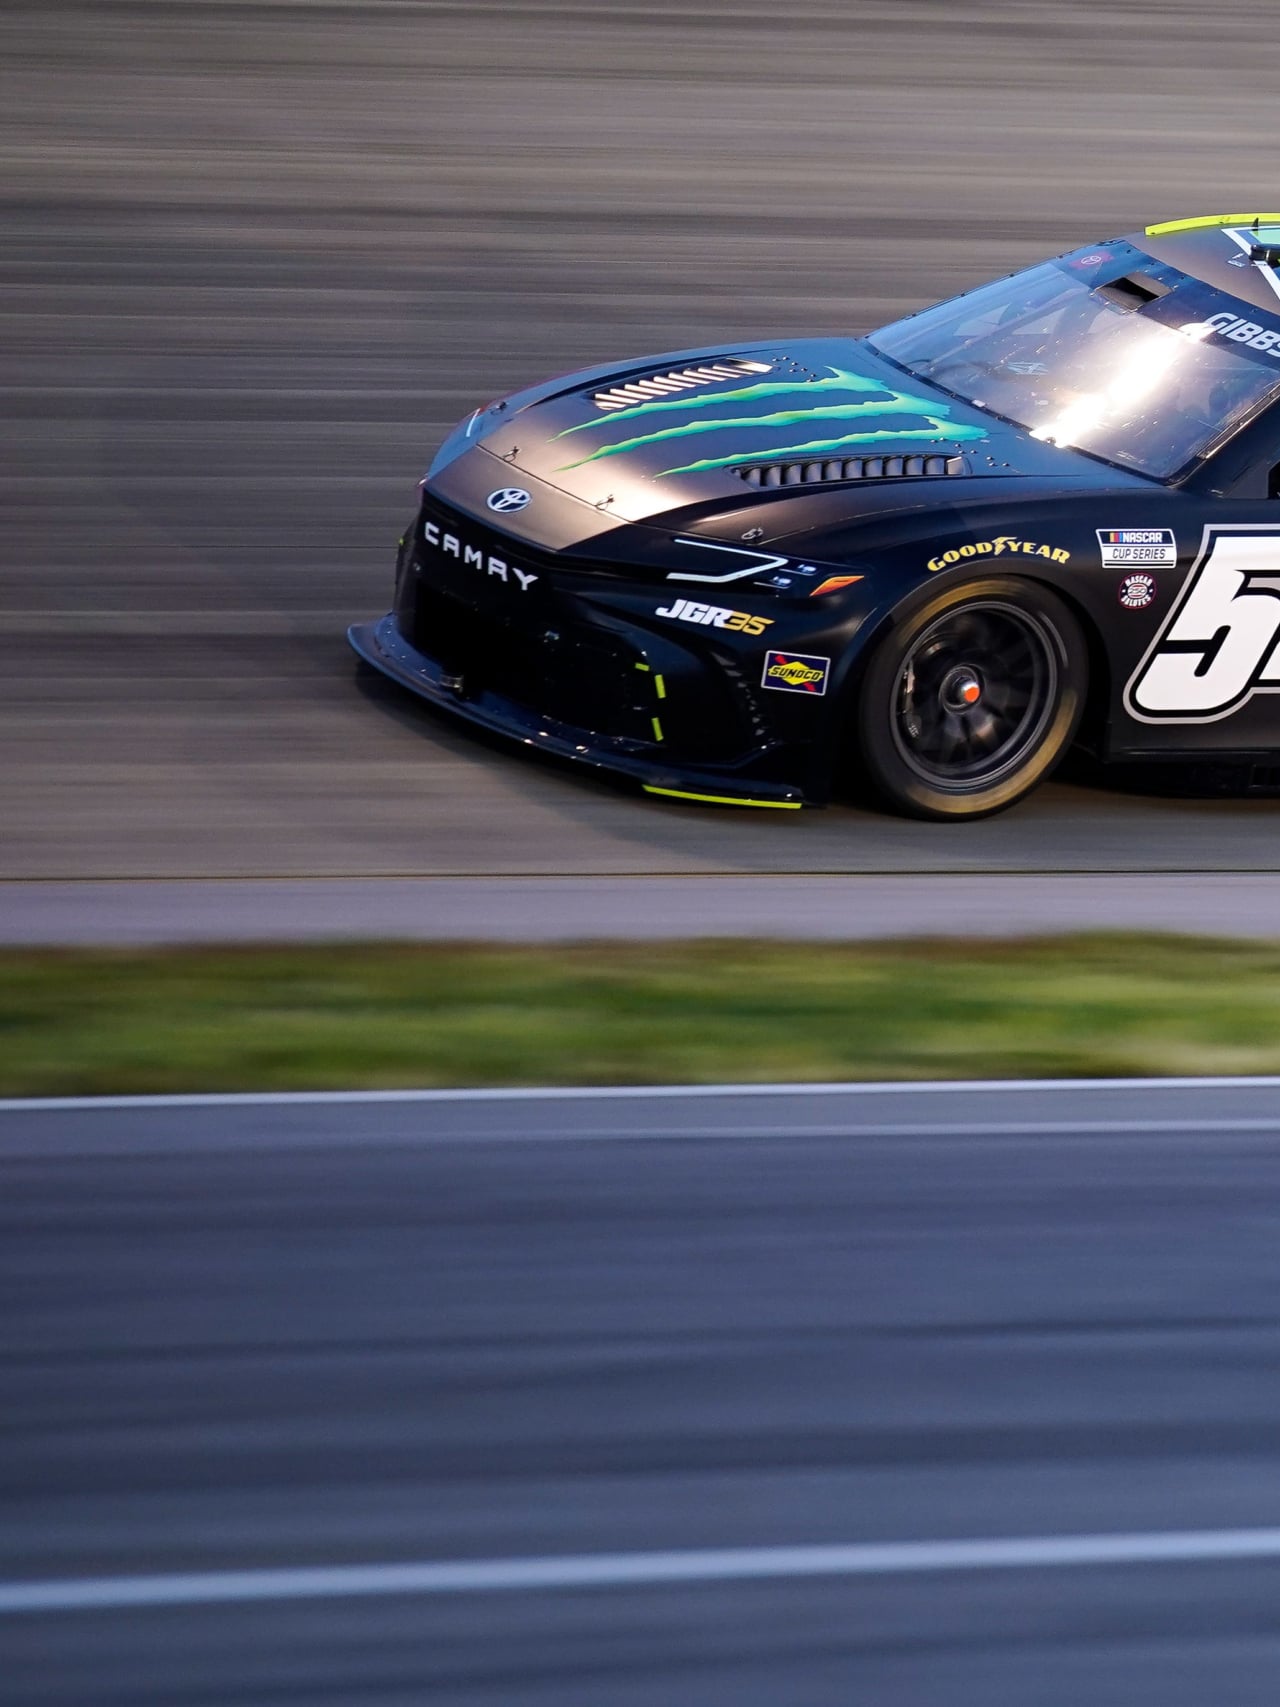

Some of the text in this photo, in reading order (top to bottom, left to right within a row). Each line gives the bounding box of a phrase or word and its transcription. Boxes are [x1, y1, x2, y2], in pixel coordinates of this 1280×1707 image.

[1122, 532, 1163, 543] NASCAR
[424, 521, 539, 591] CAMRY
[927, 536, 1071, 572] GOODYEAR
[1112, 548, 1166, 559] CUP SERIES
[771, 666, 823, 682] SUNOCO
